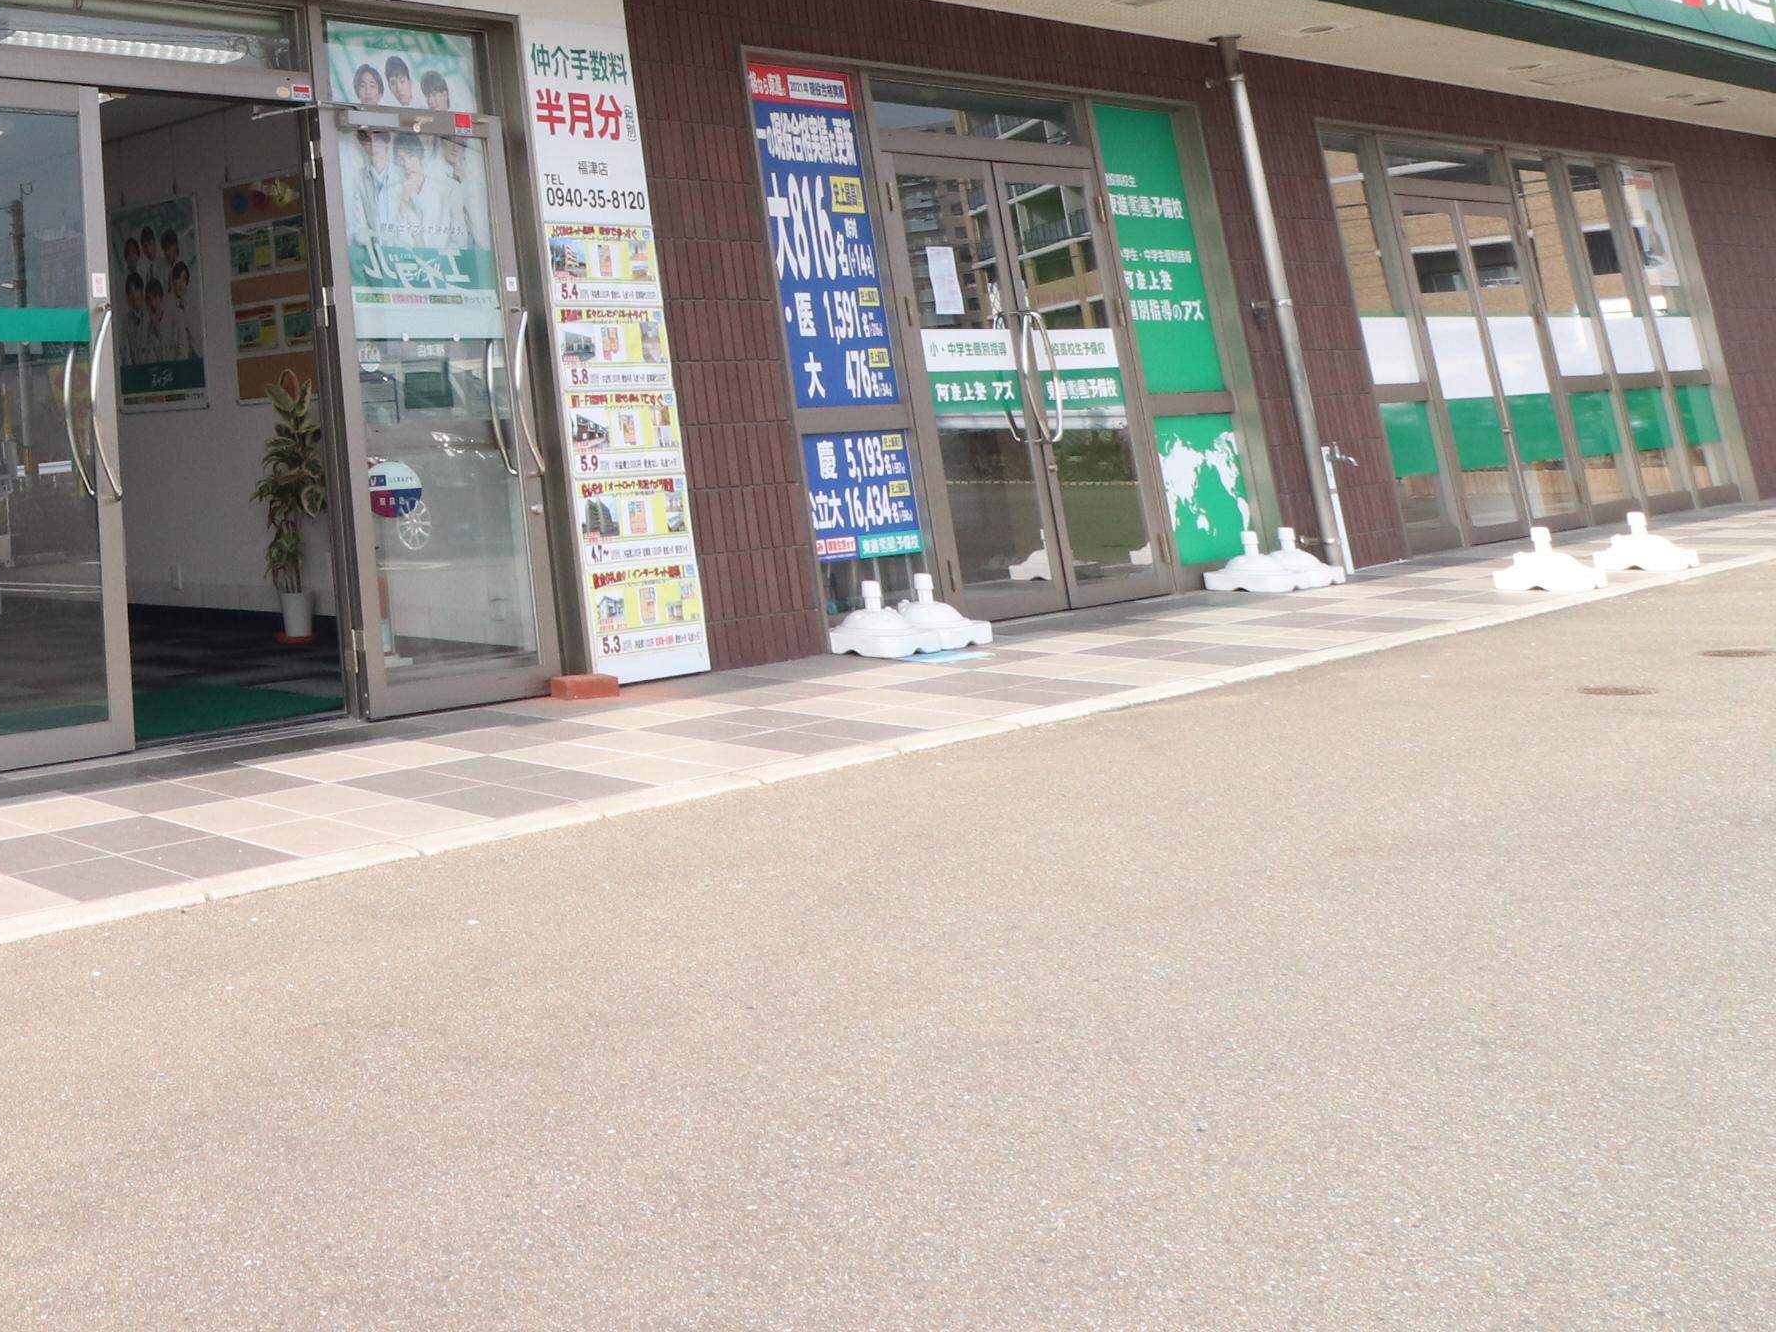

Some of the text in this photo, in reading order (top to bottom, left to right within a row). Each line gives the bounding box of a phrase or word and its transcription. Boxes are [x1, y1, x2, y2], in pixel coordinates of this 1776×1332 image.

[530, 42, 629, 86] 仲介手数料
[536, 88, 623, 141] 半月分
[544, 173, 565, 186] TEL
[577, 160, 609, 177] 福津店
[546, 187, 646, 210] 0940-35-8120
